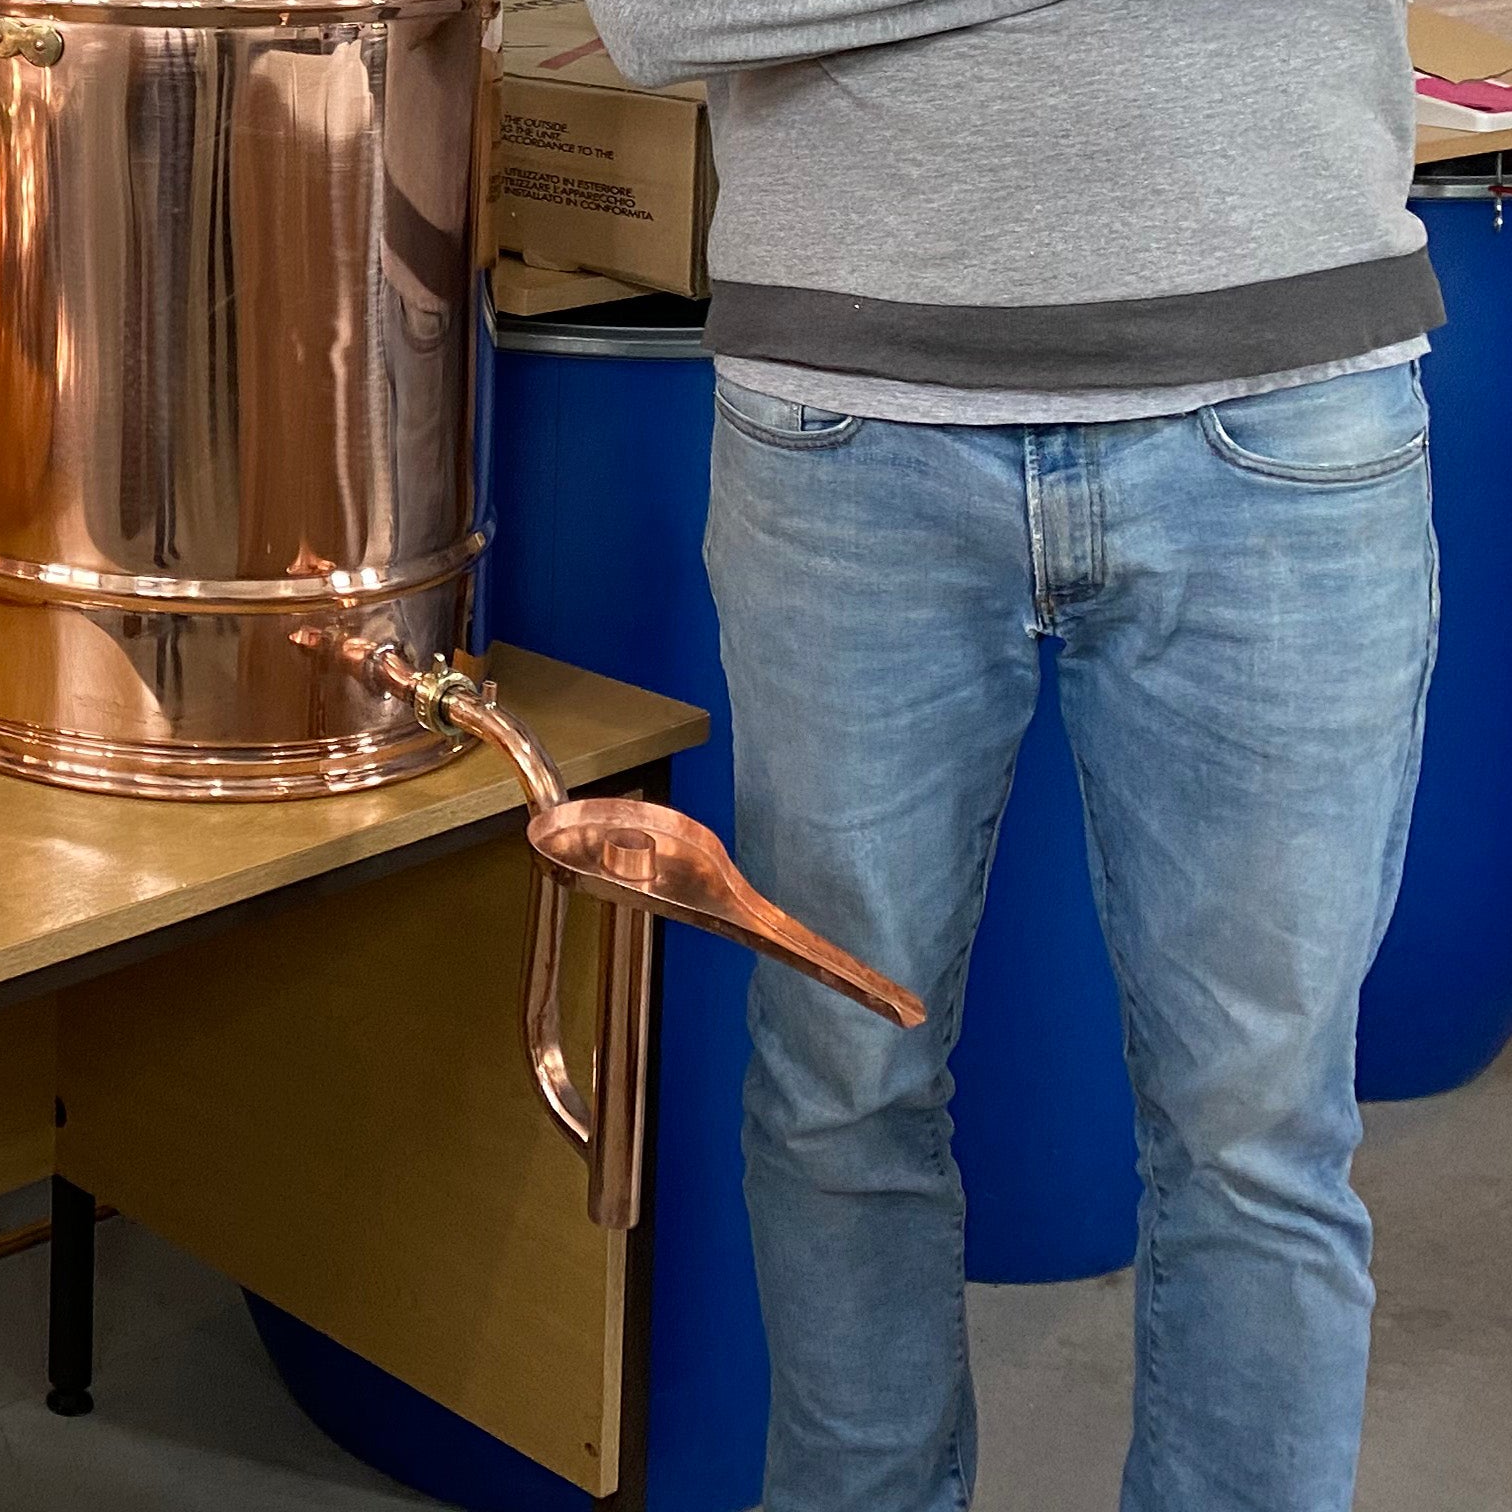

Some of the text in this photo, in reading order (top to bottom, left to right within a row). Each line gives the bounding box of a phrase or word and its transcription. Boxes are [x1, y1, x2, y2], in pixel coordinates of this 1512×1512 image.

[504, 114, 523, 126] THE
[516, 126, 533, 138] THE
[501, 134, 614, 160] ACCORDANCE TO THE
[504, 167, 560, 184] UTILIZZATO
[563, 177, 575, 188] IN
[504, 186, 564, 205] INSTALLATO
[565, 197, 578, 207] IN
